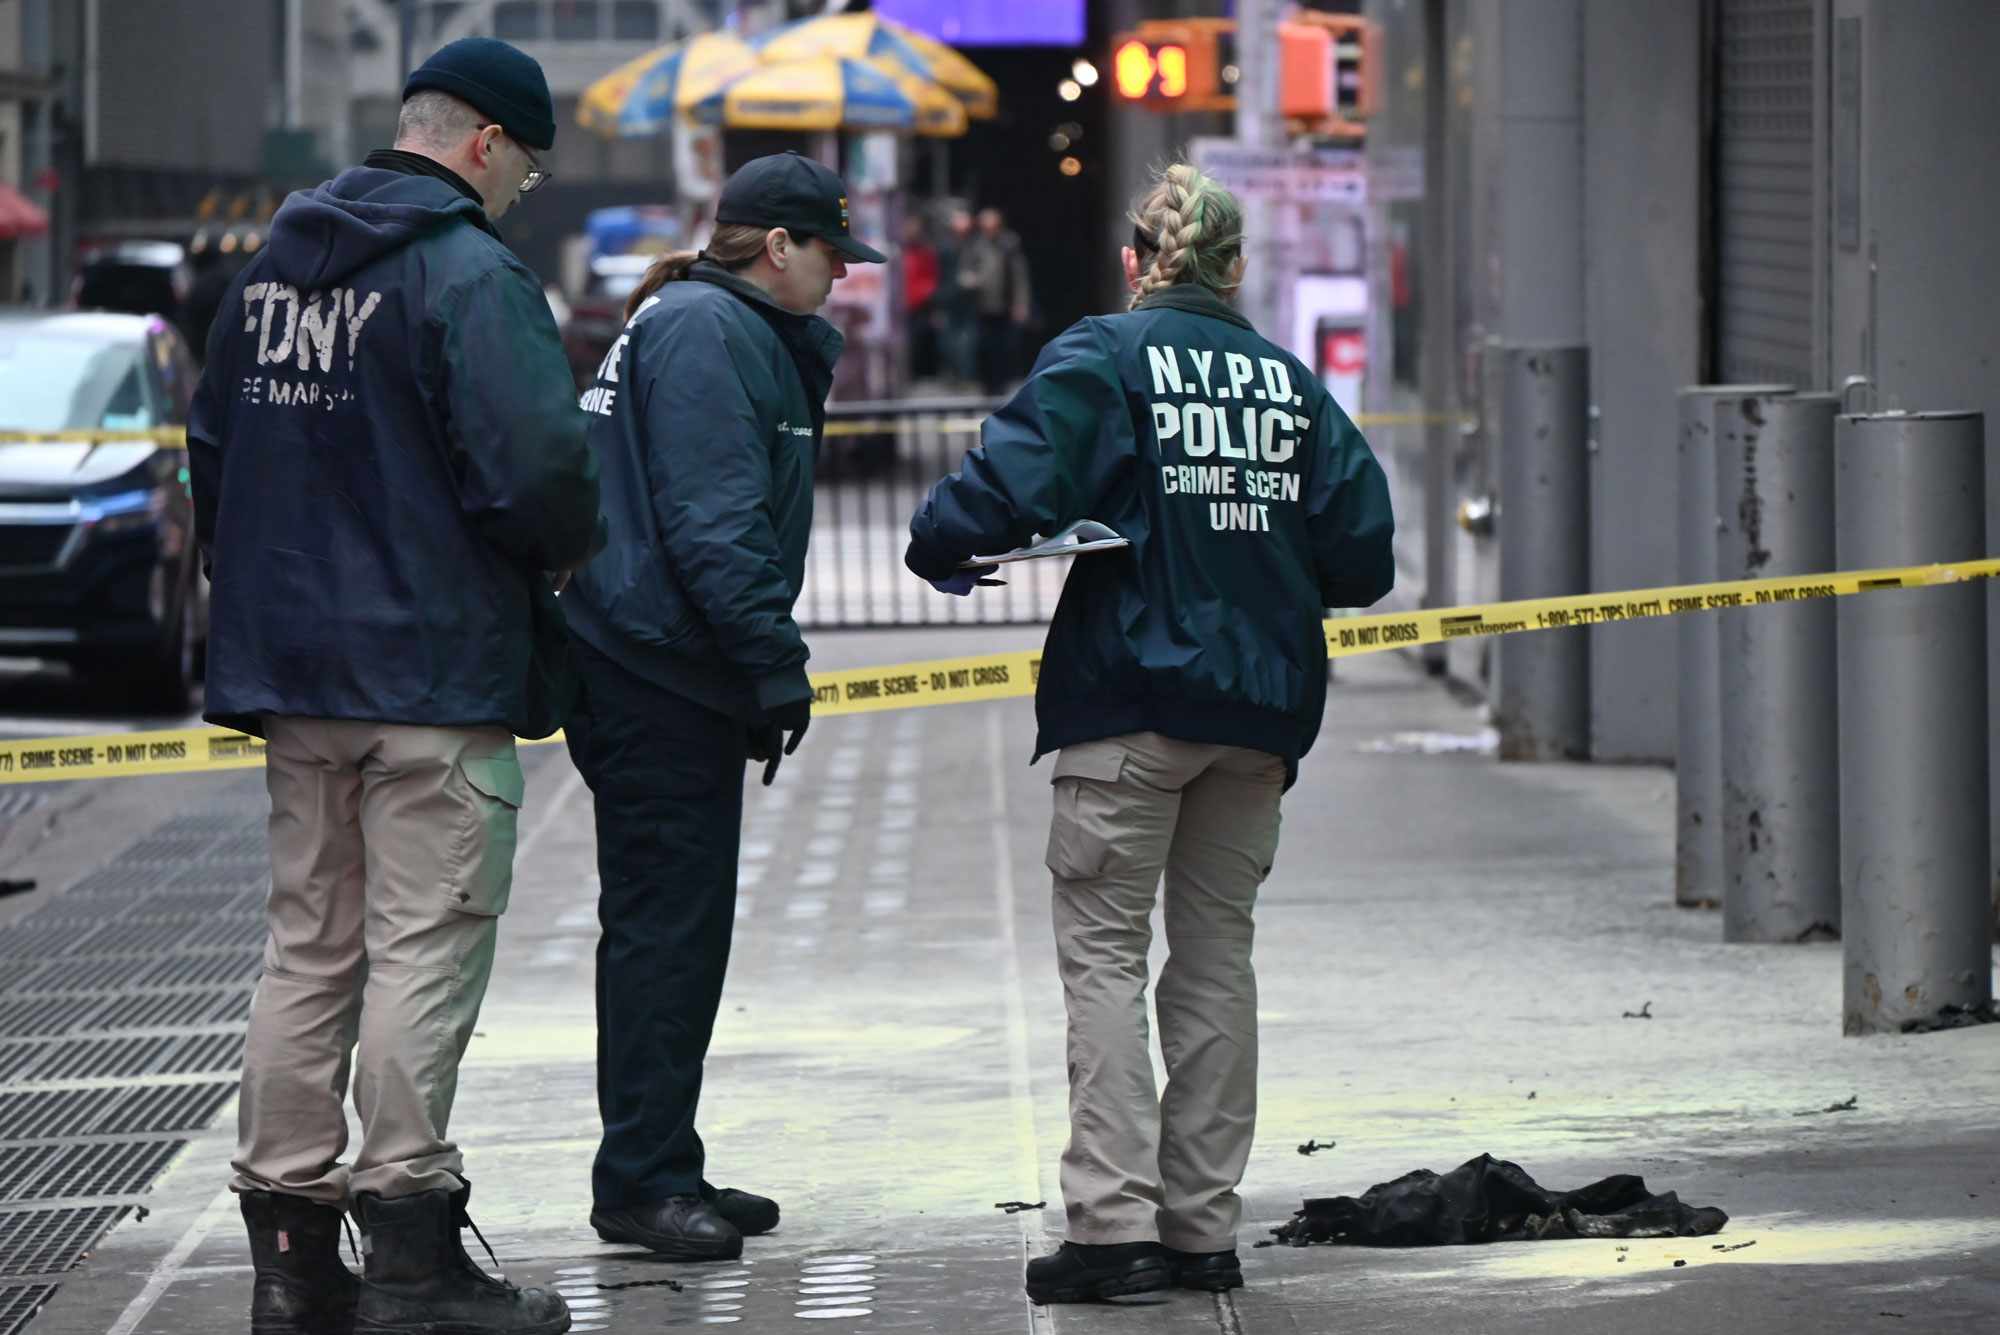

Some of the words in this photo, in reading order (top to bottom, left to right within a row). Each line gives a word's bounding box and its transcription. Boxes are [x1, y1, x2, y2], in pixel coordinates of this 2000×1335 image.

[1146, 346, 1303, 406] N.Y.P.D.
[1162, 465, 1236, 494] CRIME
[1209, 502, 1269, 532] UNIT
[1340, 628, 1355, 647] DO
[1359, 626, 1379, 645] NOT
[1383, 623, 1419, 642] CROSS
[1707, 592, 1742, 608] SCENE
[1756, 590, 1771, 604] DO
[846, 680, 880, 700] CRIME
[883, 675, 918, 695] SCENE
[931, 672, 946, 691] DO
[949, 669, 970, 689] NOT
[973, 665, 1009, 686] CROSS
[20, 750, 55, 769] CRIME
[59, 748, 94, 767] SCENE
[107, 746, 122, 763] DO
[125, 744, 146, 762] NOT
[150, 741, 186, 759] CROSS
